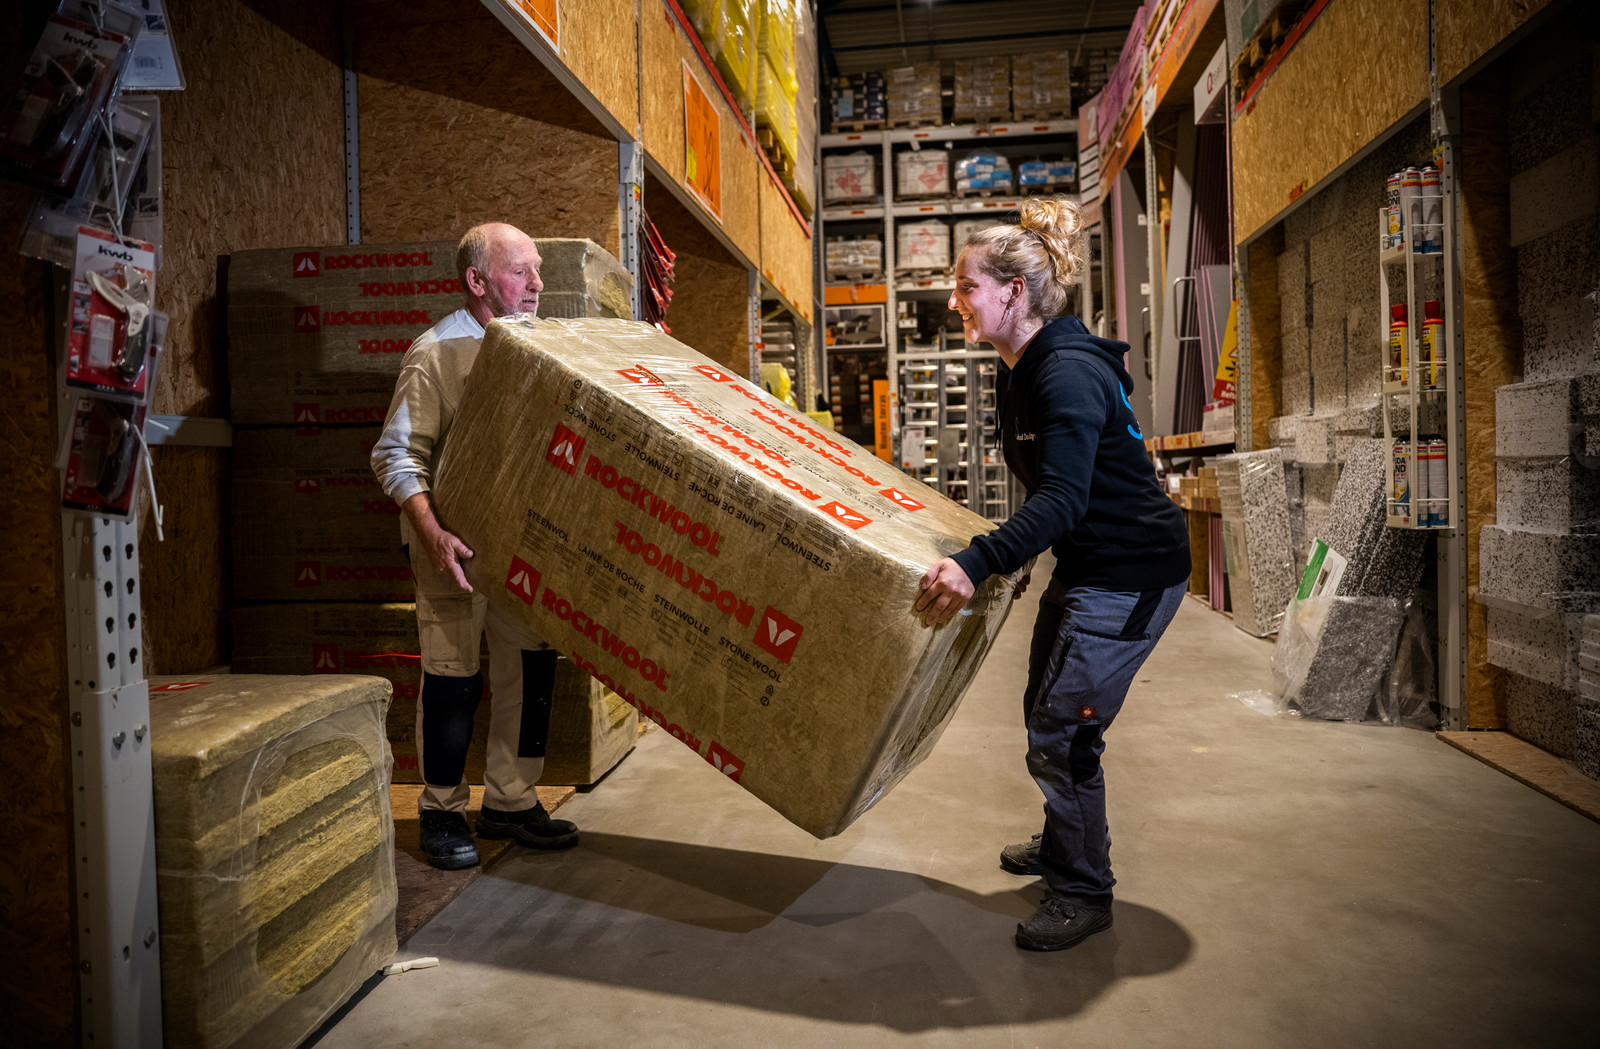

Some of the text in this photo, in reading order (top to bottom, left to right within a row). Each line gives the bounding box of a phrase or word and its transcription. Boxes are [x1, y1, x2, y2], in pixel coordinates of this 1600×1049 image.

[62, 31, 98, 51] kwb
[98, 245, 134, 262] kwb
[324, 251, 433, 270] ROCKWOOL
[324, 309, 433, 326] ROCKWOOL
[358, 339, 413, 354] WOOL
[324, 406, 388, 423] ROCK
[729, 384, 852, 458] ROCKWOOL
[588, 419, 617, 443] STONE
[659, 390, 792, 468] ROCKWOOL
[747, 408, 882, 487] ROCKWOOL
[624, 442, 680, 481] STEINWOLLE
[584, 454, 721, 557] ROCKWOOL
[688, 482, 721, 506] ROCHE
[721, 501, 735, 515] DE
[735, 510, 767, 533] LAINE
[777, 532, 832, 572] STEENWOL
[325, 566, 412, 581] ROCKWO
[614, 521, 755, 628] ROCKWOOL
[527, 508, 569, 543] STEENWOL
[577, 543, 602, 564] LAINE
[602, 560, 615, 572] DE
[615, 568, 646, 594] ROCHE
[653, 594, 710, 636] STEINWOLLE
[718, 636, 752, 663] STONE
[752, 657, 782, 683] WOOL
[541, 587, 669, 692] ROCKWOOL
[344, 651, 421, 668] ROCKW
